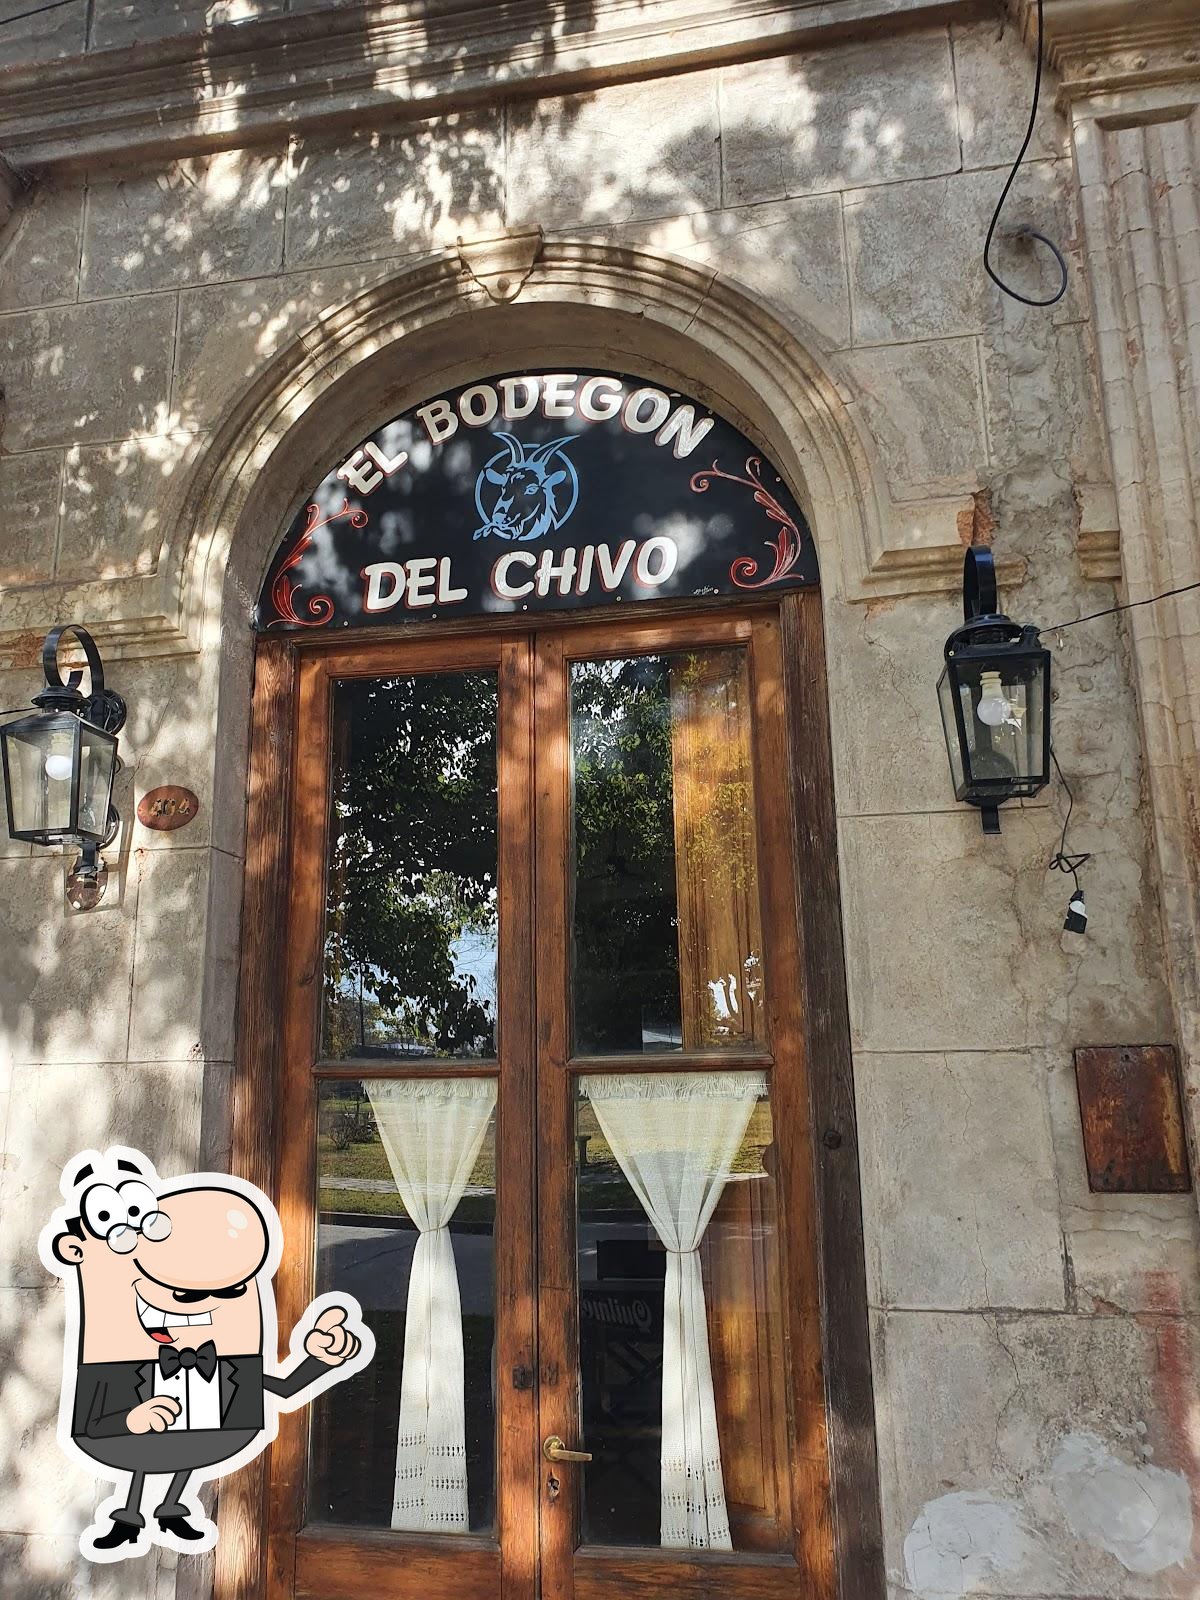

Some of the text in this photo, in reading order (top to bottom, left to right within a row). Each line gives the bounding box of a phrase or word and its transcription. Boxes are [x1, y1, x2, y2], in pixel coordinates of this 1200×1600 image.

[338, 440, 408, 494] EL
[363, 536, 679, 611] DEL CHIVO
